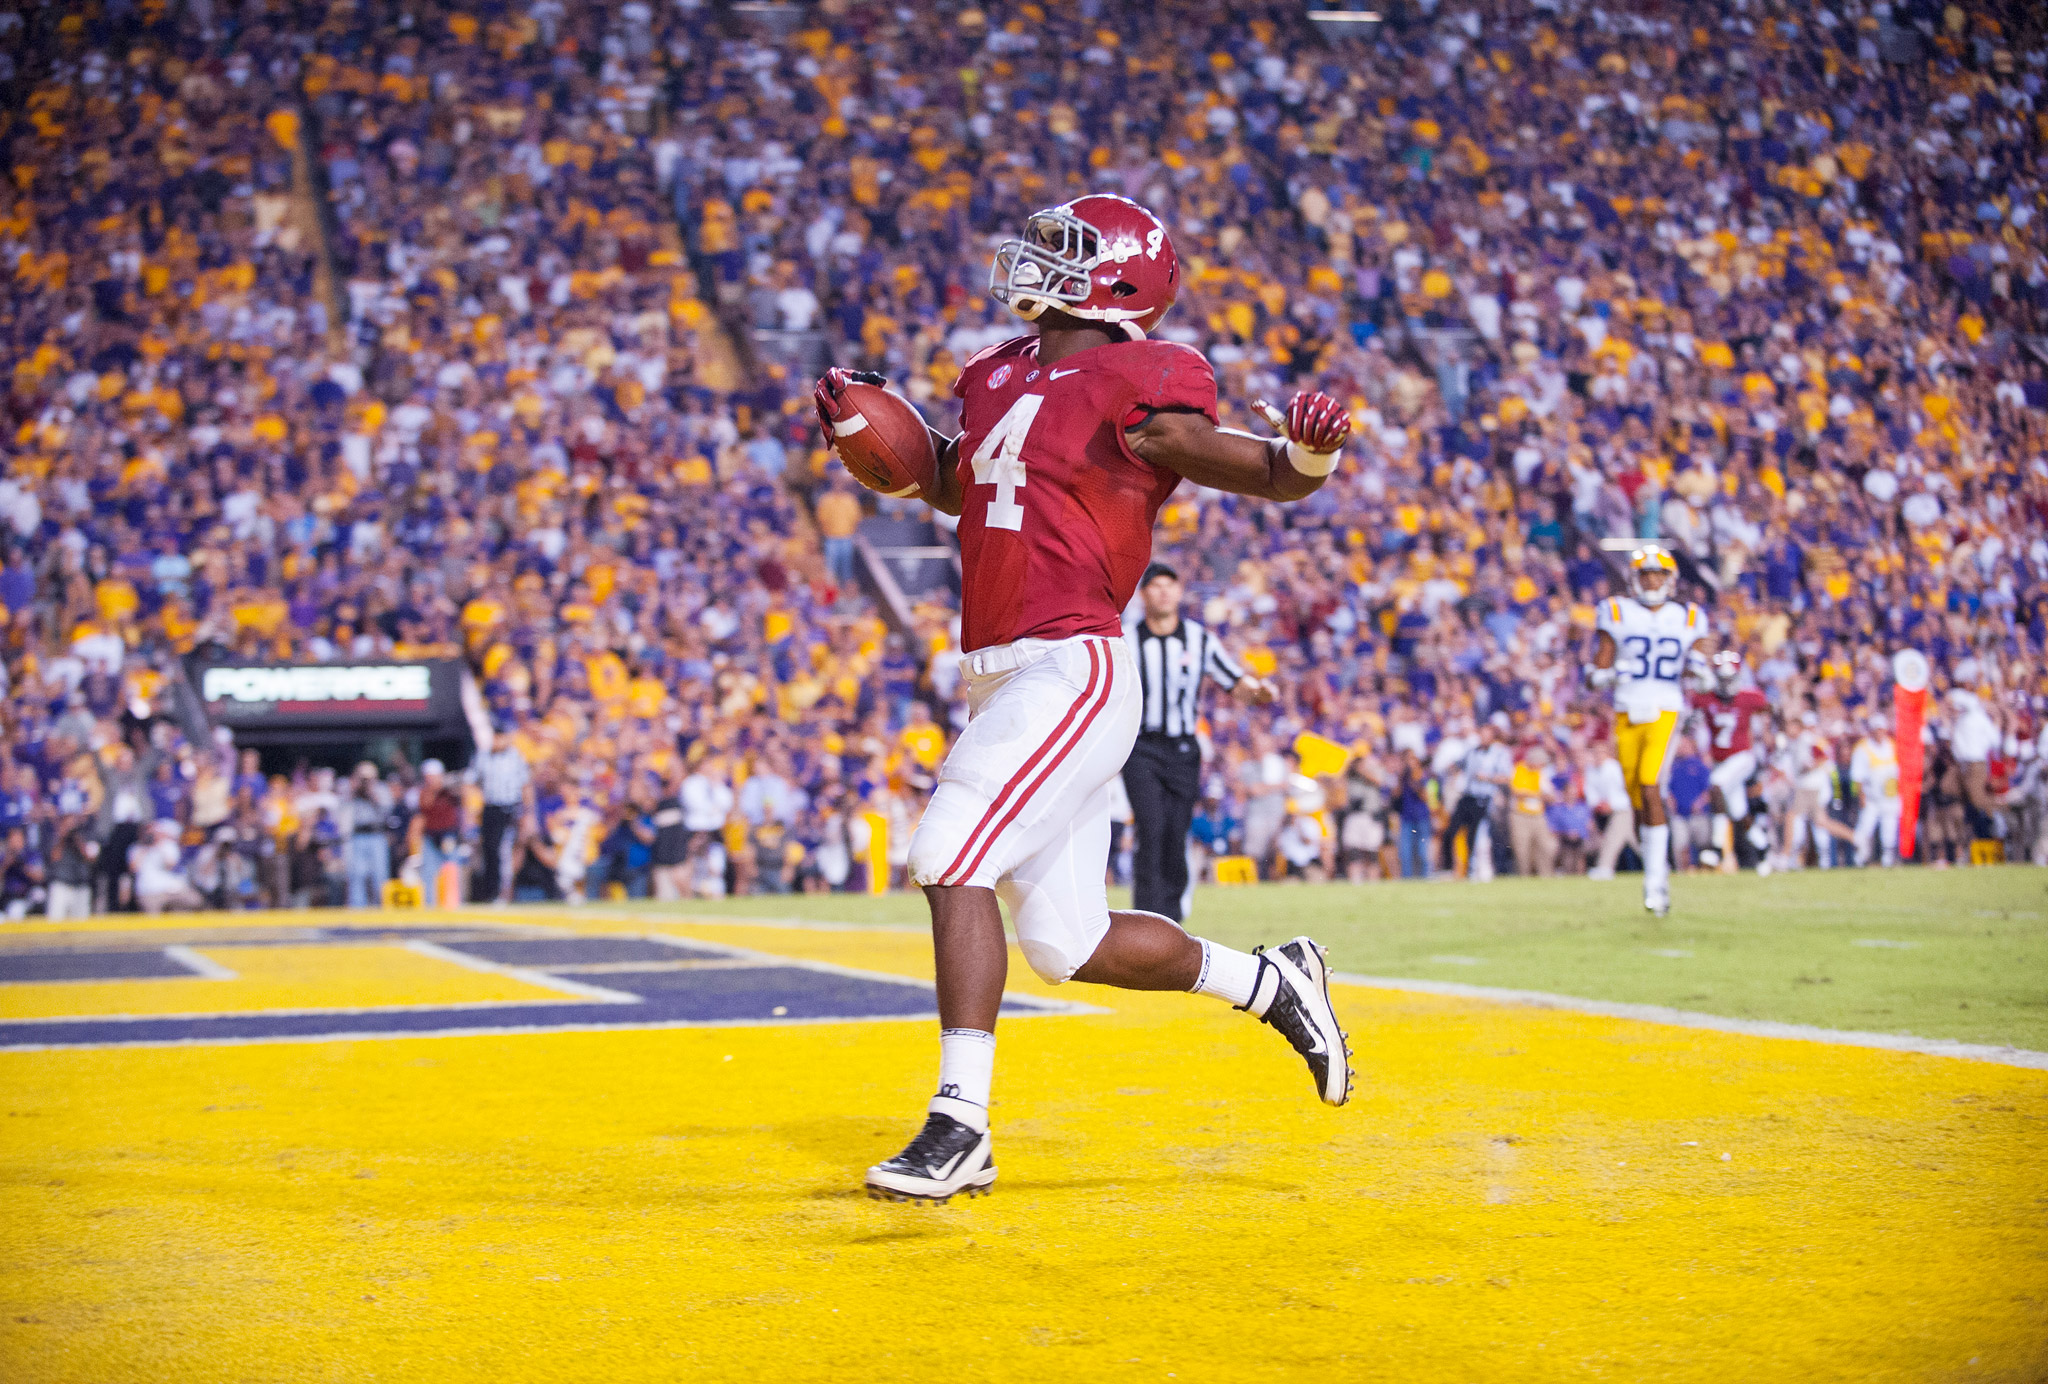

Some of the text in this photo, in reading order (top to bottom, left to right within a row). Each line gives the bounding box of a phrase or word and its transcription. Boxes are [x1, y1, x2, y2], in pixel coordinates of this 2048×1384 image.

[1145, 228, 1164, 262] 4
[970, 393, 1045, 532] 4
[1622, 635, 1683, 681] 32
[1713, 712, 1738, 750] 7
